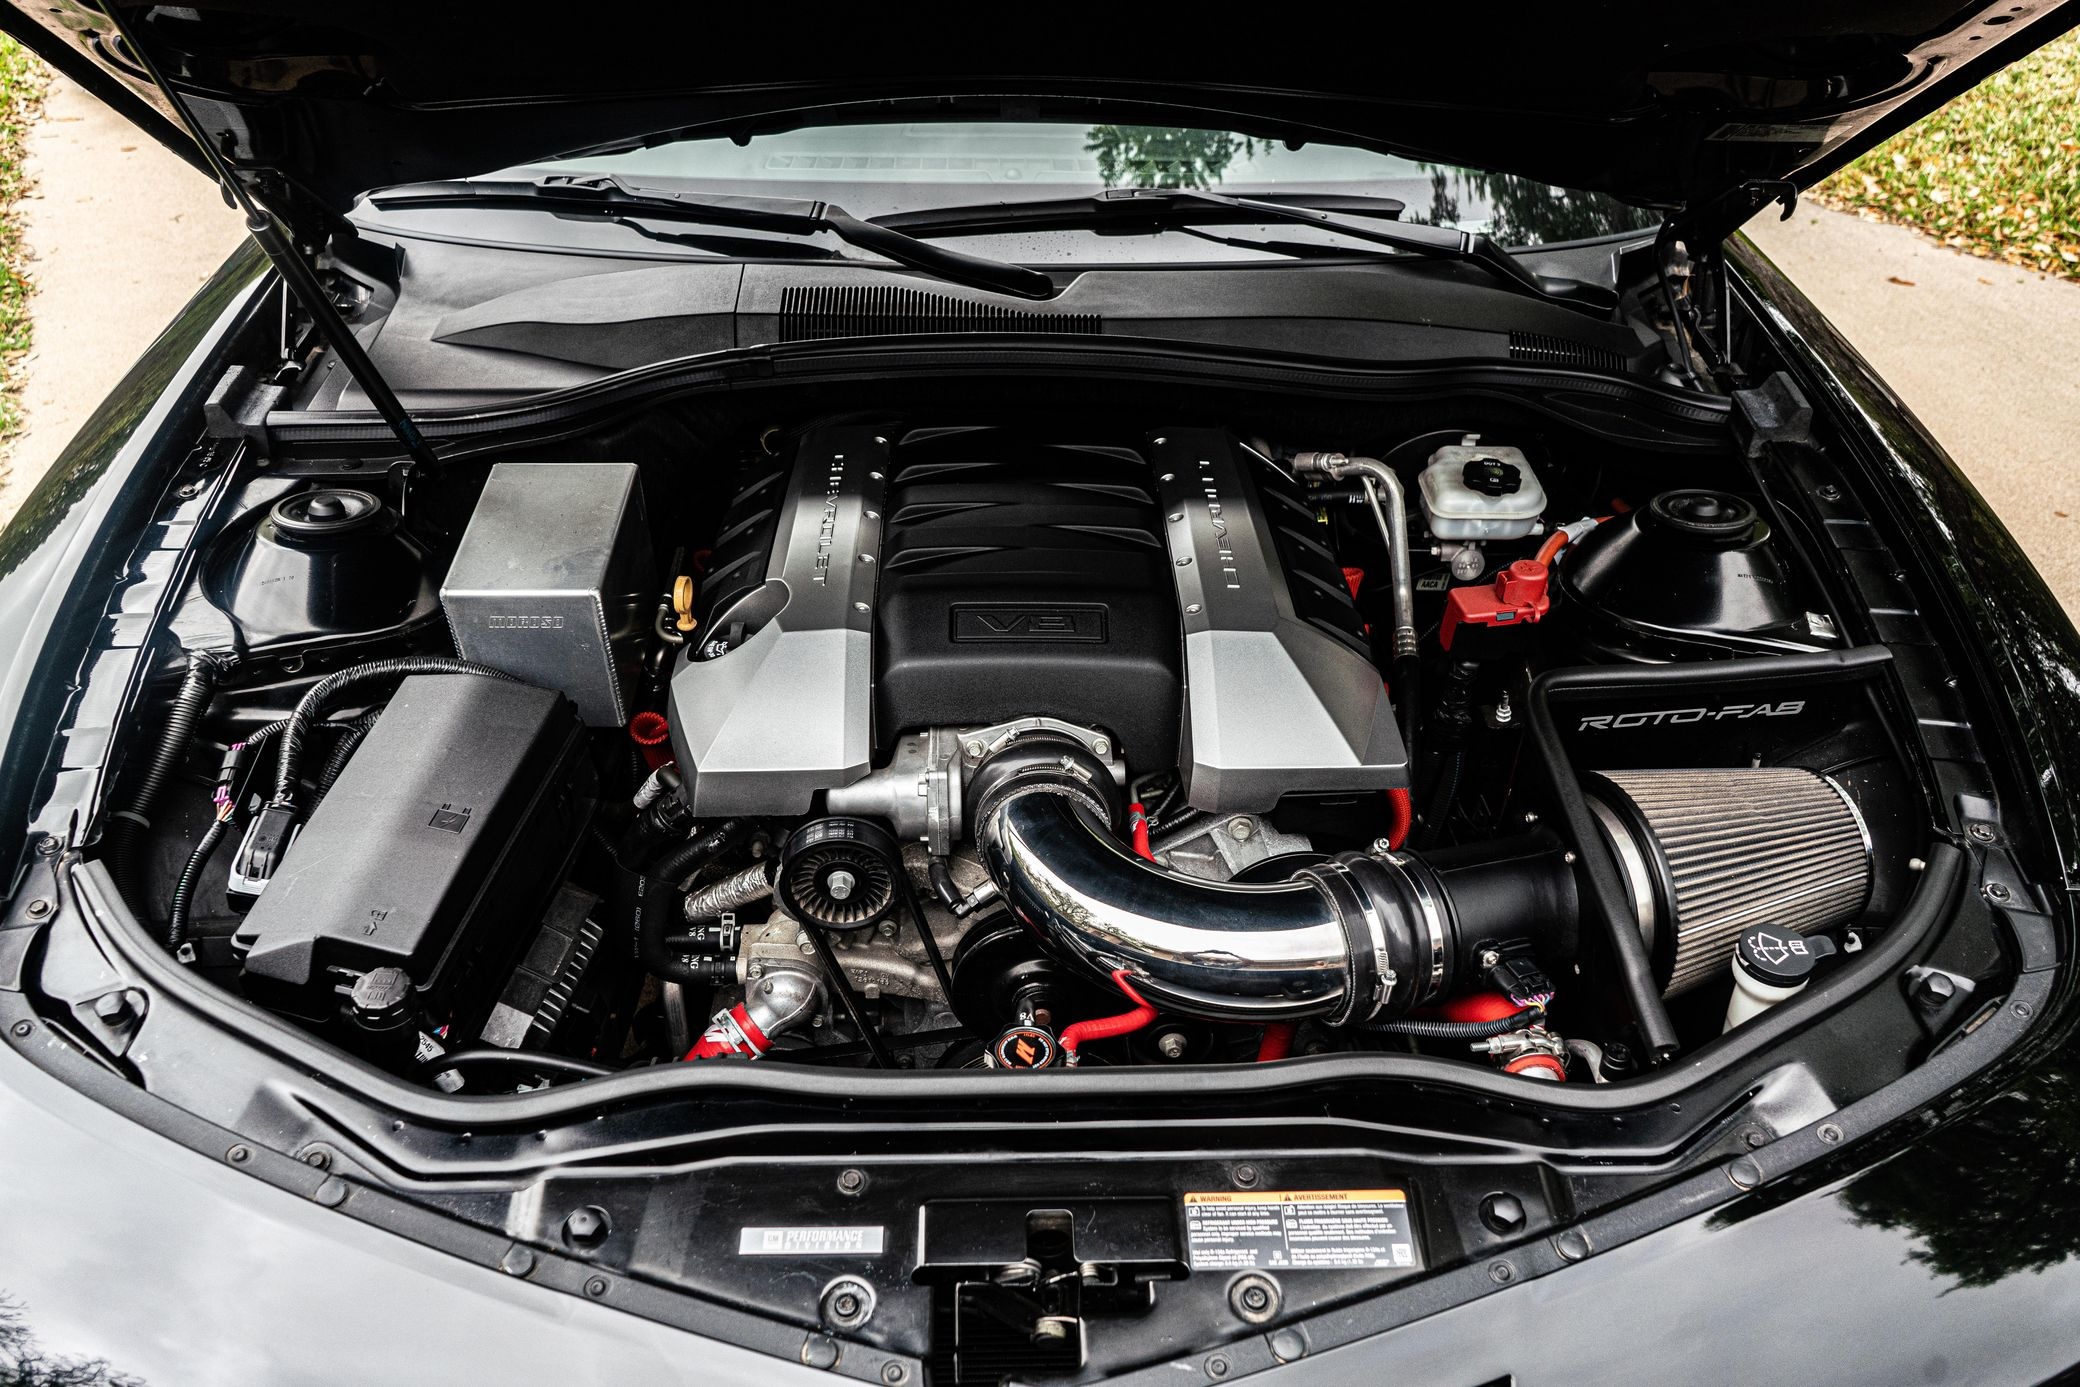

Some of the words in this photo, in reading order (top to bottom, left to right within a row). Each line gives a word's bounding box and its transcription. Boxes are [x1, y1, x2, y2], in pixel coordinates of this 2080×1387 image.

[813, 454, 844, 586] CHEVROLET
[488, 616, 564, 629] MOROSO
[976, 614, 1075, 633] V8
[1578, 701, 1806, 731] ROTO-FAB
[1200, 1195, 1232, 1203] WARNING
[785, 1230, 864, 1242] PERFORMANCE
